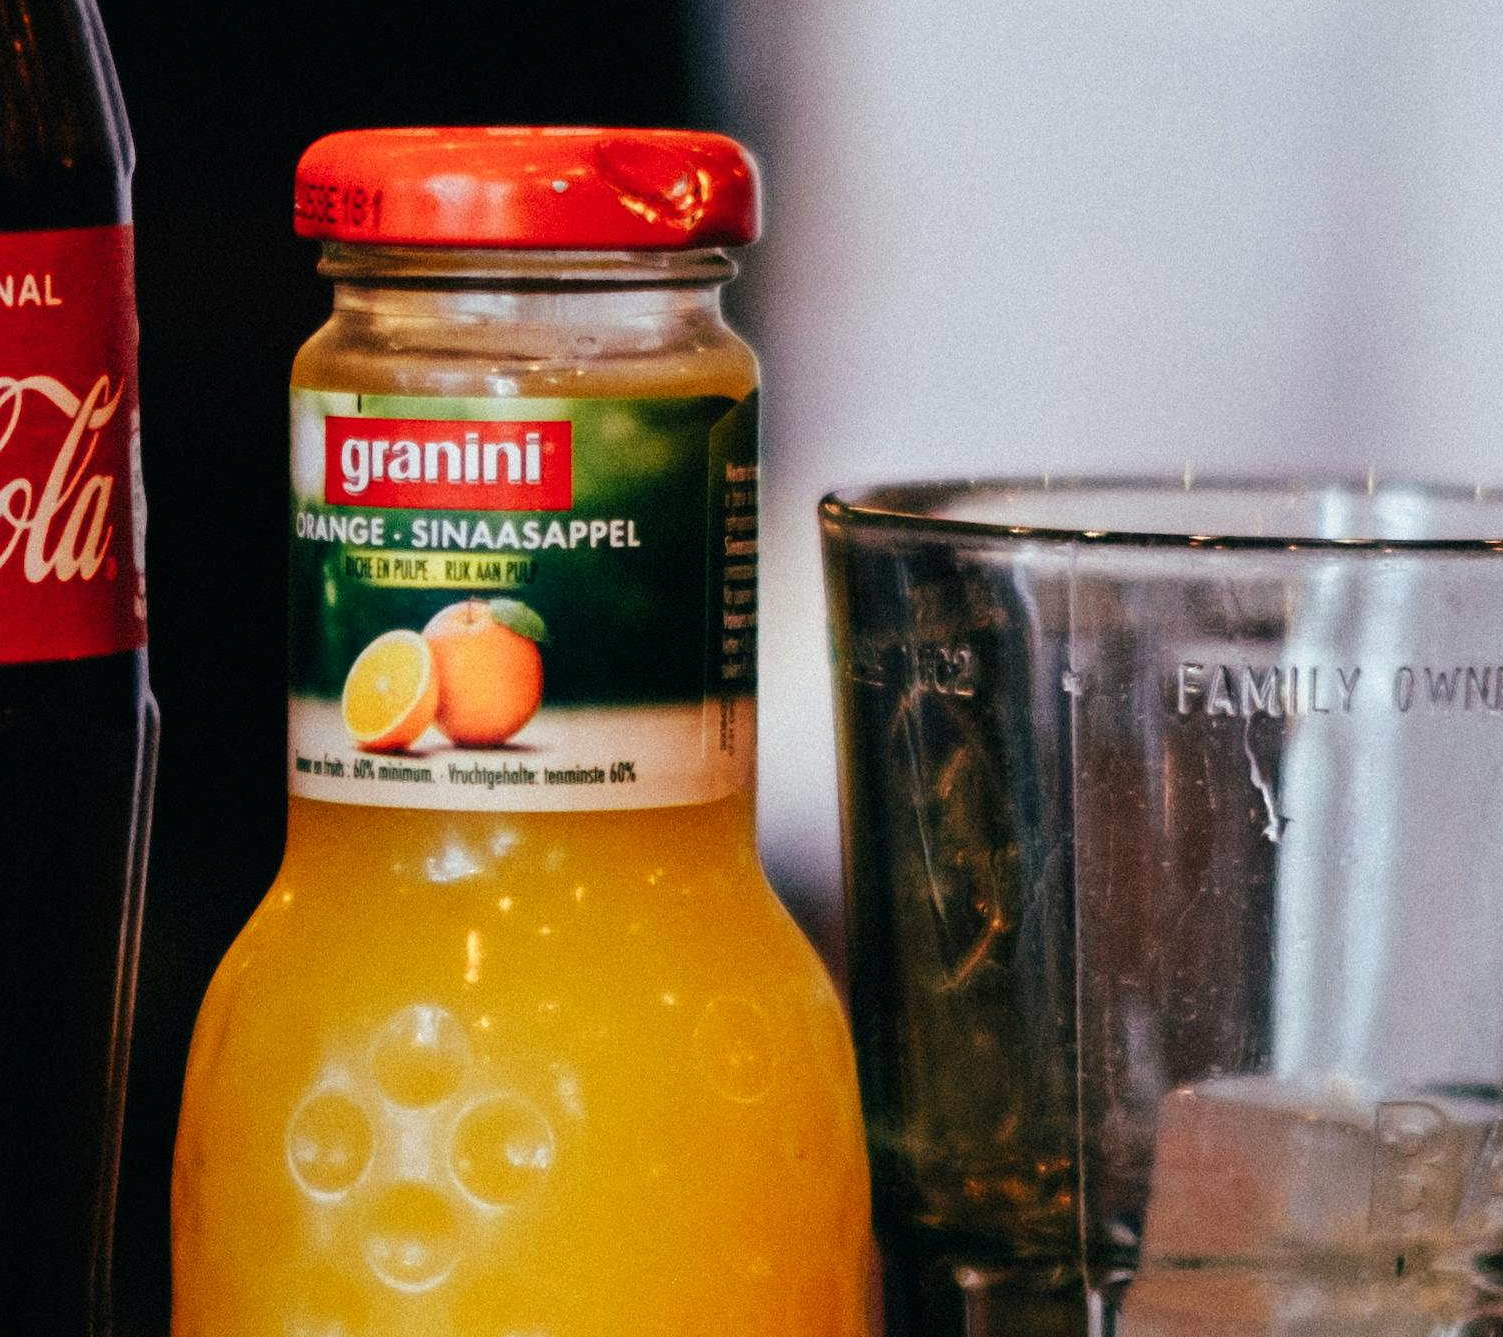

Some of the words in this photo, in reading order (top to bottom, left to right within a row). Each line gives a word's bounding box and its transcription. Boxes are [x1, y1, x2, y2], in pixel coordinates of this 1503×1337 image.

[341, 432, 542, 495] granini
[296, 512, 384, 546] ORANGE
[411, 518, 640, 550] SINAASAPPEL
[394, 558, 429, 581] PULPE
[476, 561, 501, 582] AAN
[1177, 663, 1360, 717] FAMILY
[544, 762, 605, 785] tenminste
[610, 761, 636, 784] 60%
